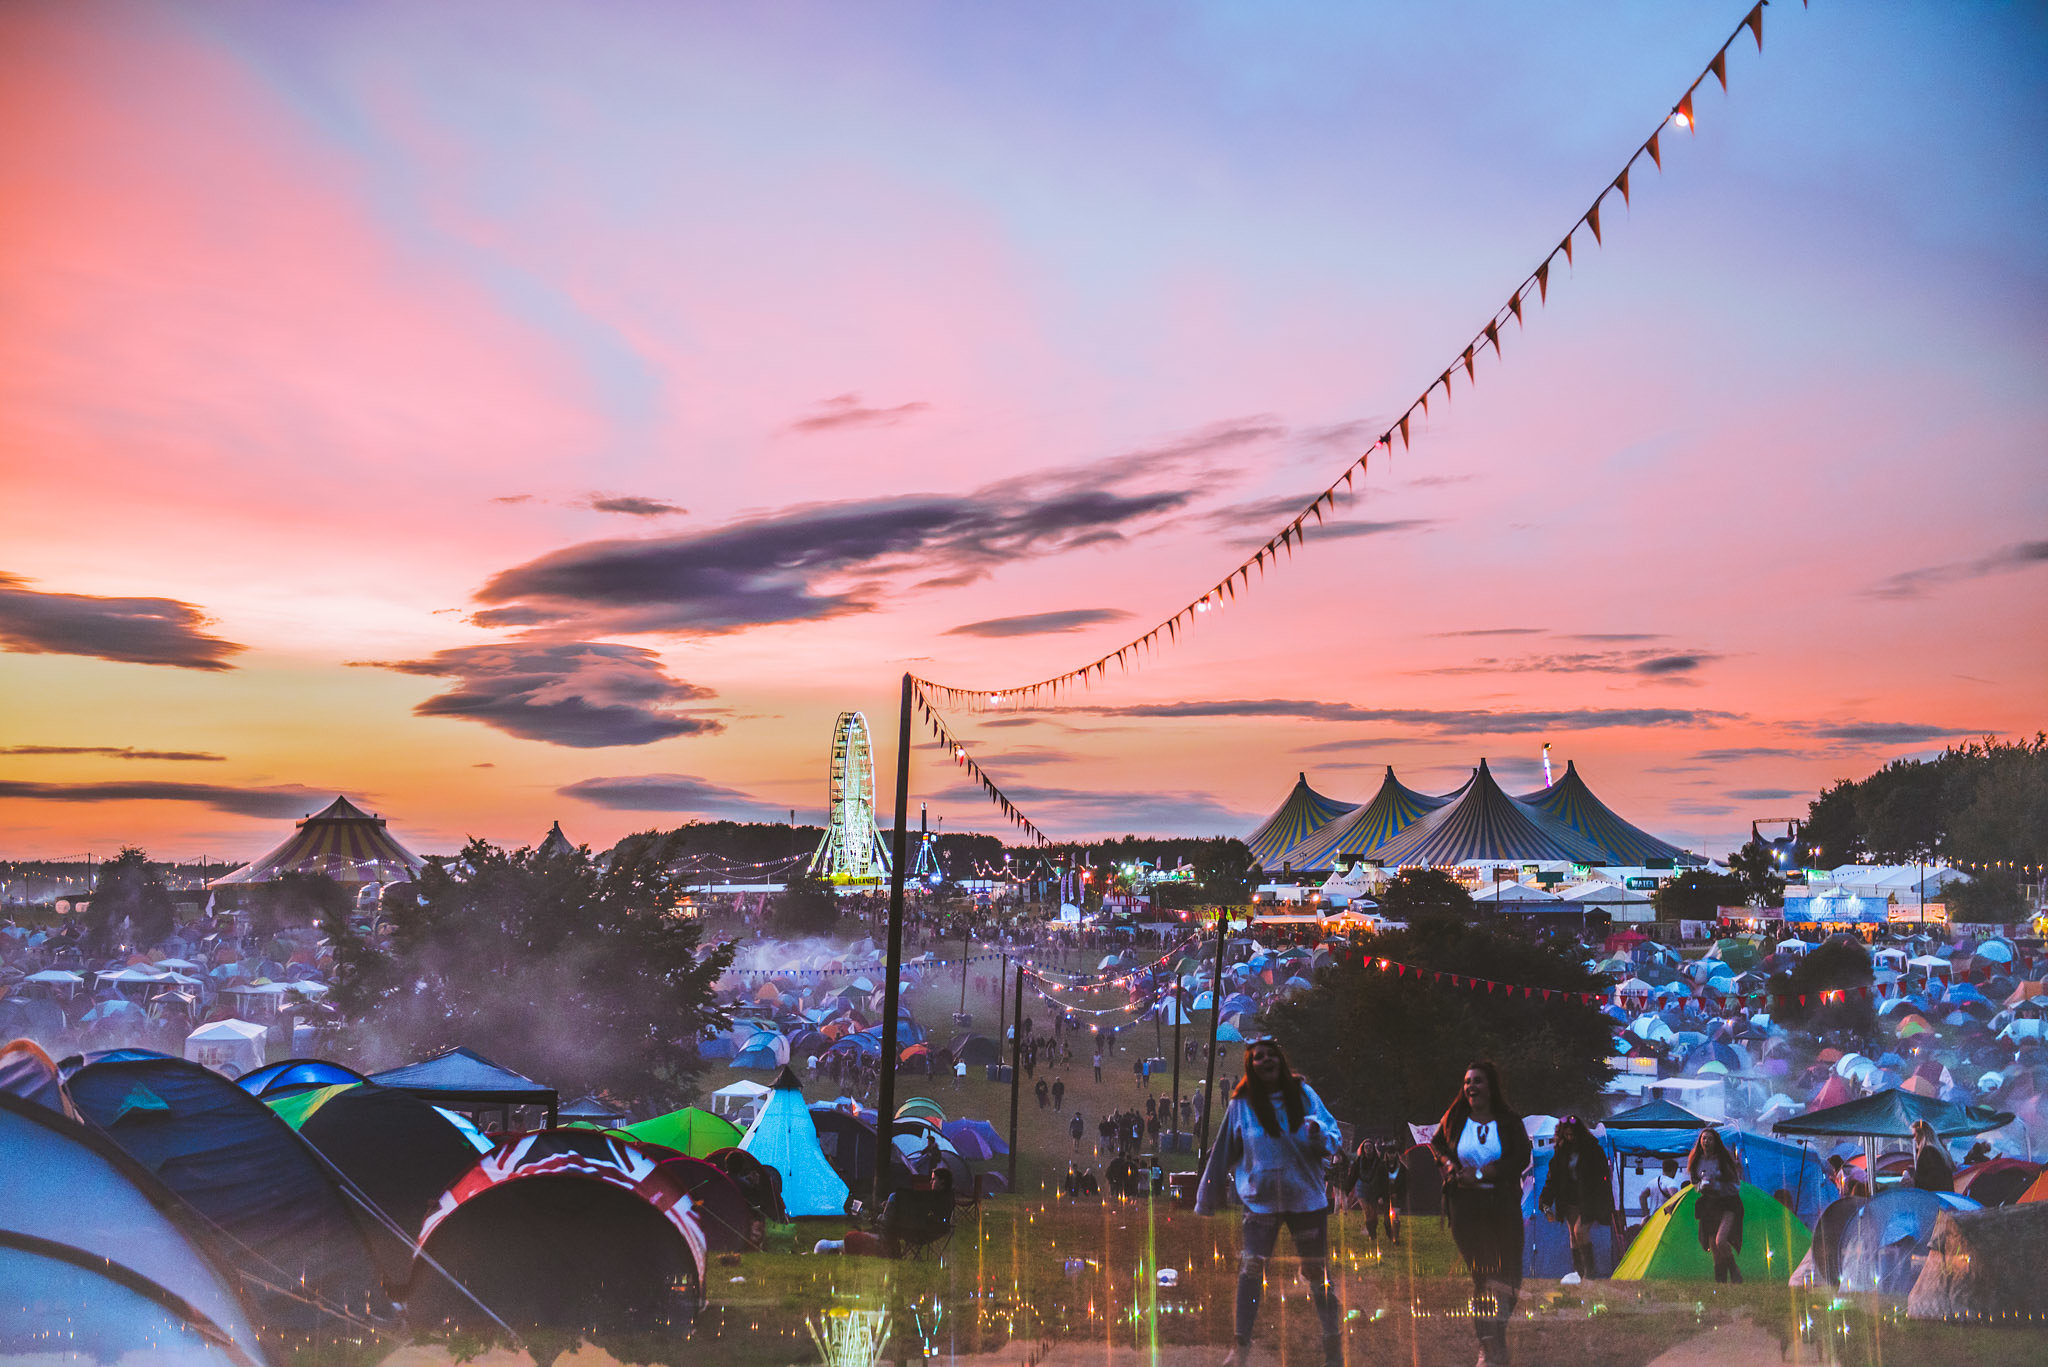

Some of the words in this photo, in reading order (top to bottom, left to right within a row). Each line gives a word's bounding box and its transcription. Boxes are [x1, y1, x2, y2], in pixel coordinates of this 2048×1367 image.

[848, 878, 875, 886] ENTRANCE
[1631, 880, 1654, 888] WATER
[1201, 905, 1247, 914] SOKS
